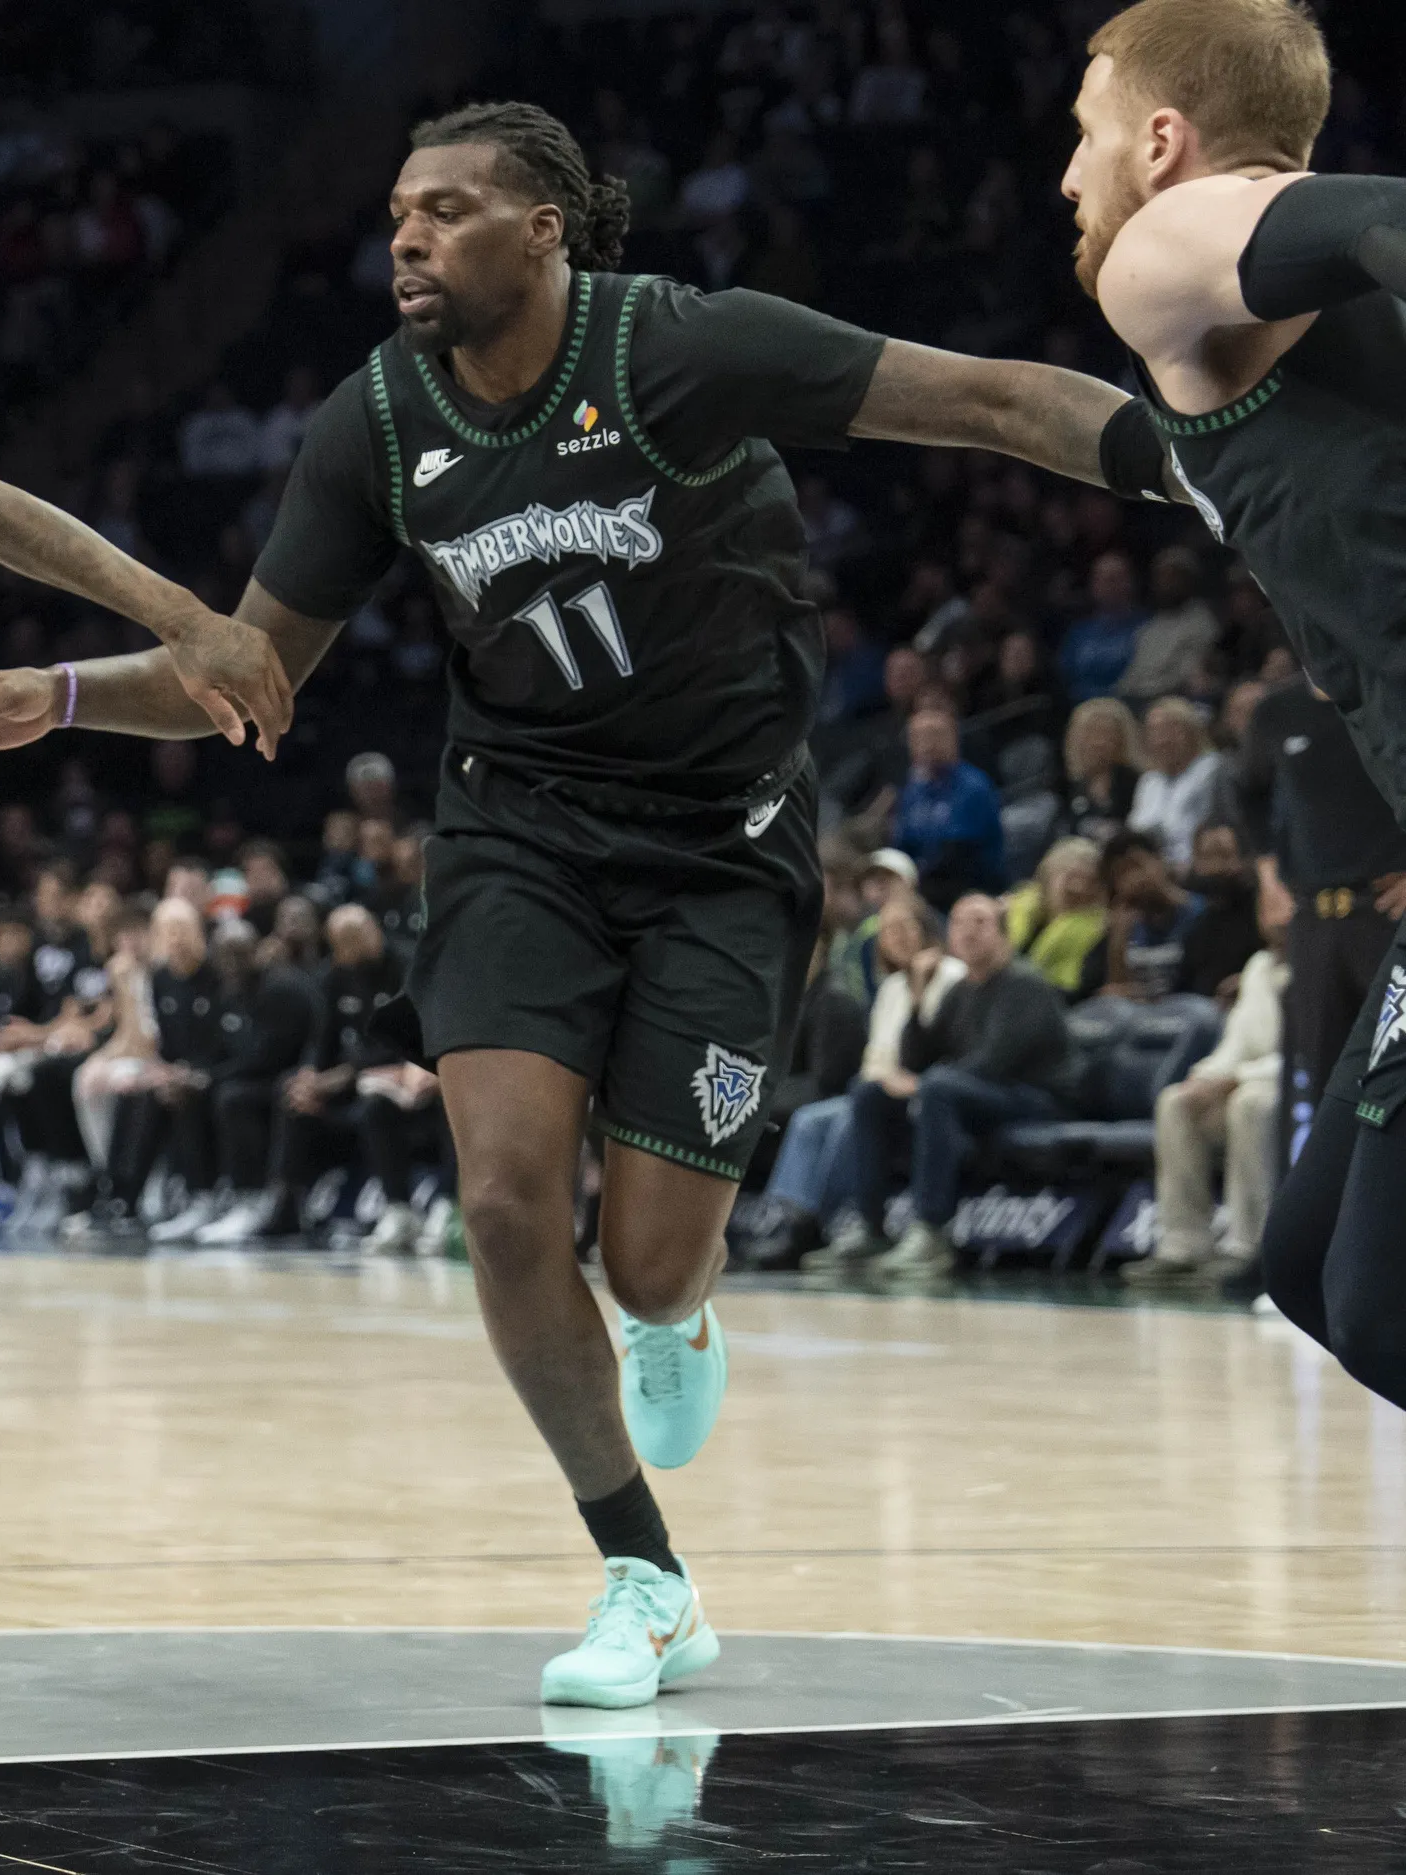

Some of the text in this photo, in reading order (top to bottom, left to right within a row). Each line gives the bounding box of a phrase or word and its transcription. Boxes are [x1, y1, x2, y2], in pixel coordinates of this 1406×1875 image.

[419, 448, 452, 474] NIKE
[556, 427, 621, 456] sezzle
[420, 485, 663, 613] TIMBERWOLVES
[512, 581, 634, 691] 11
